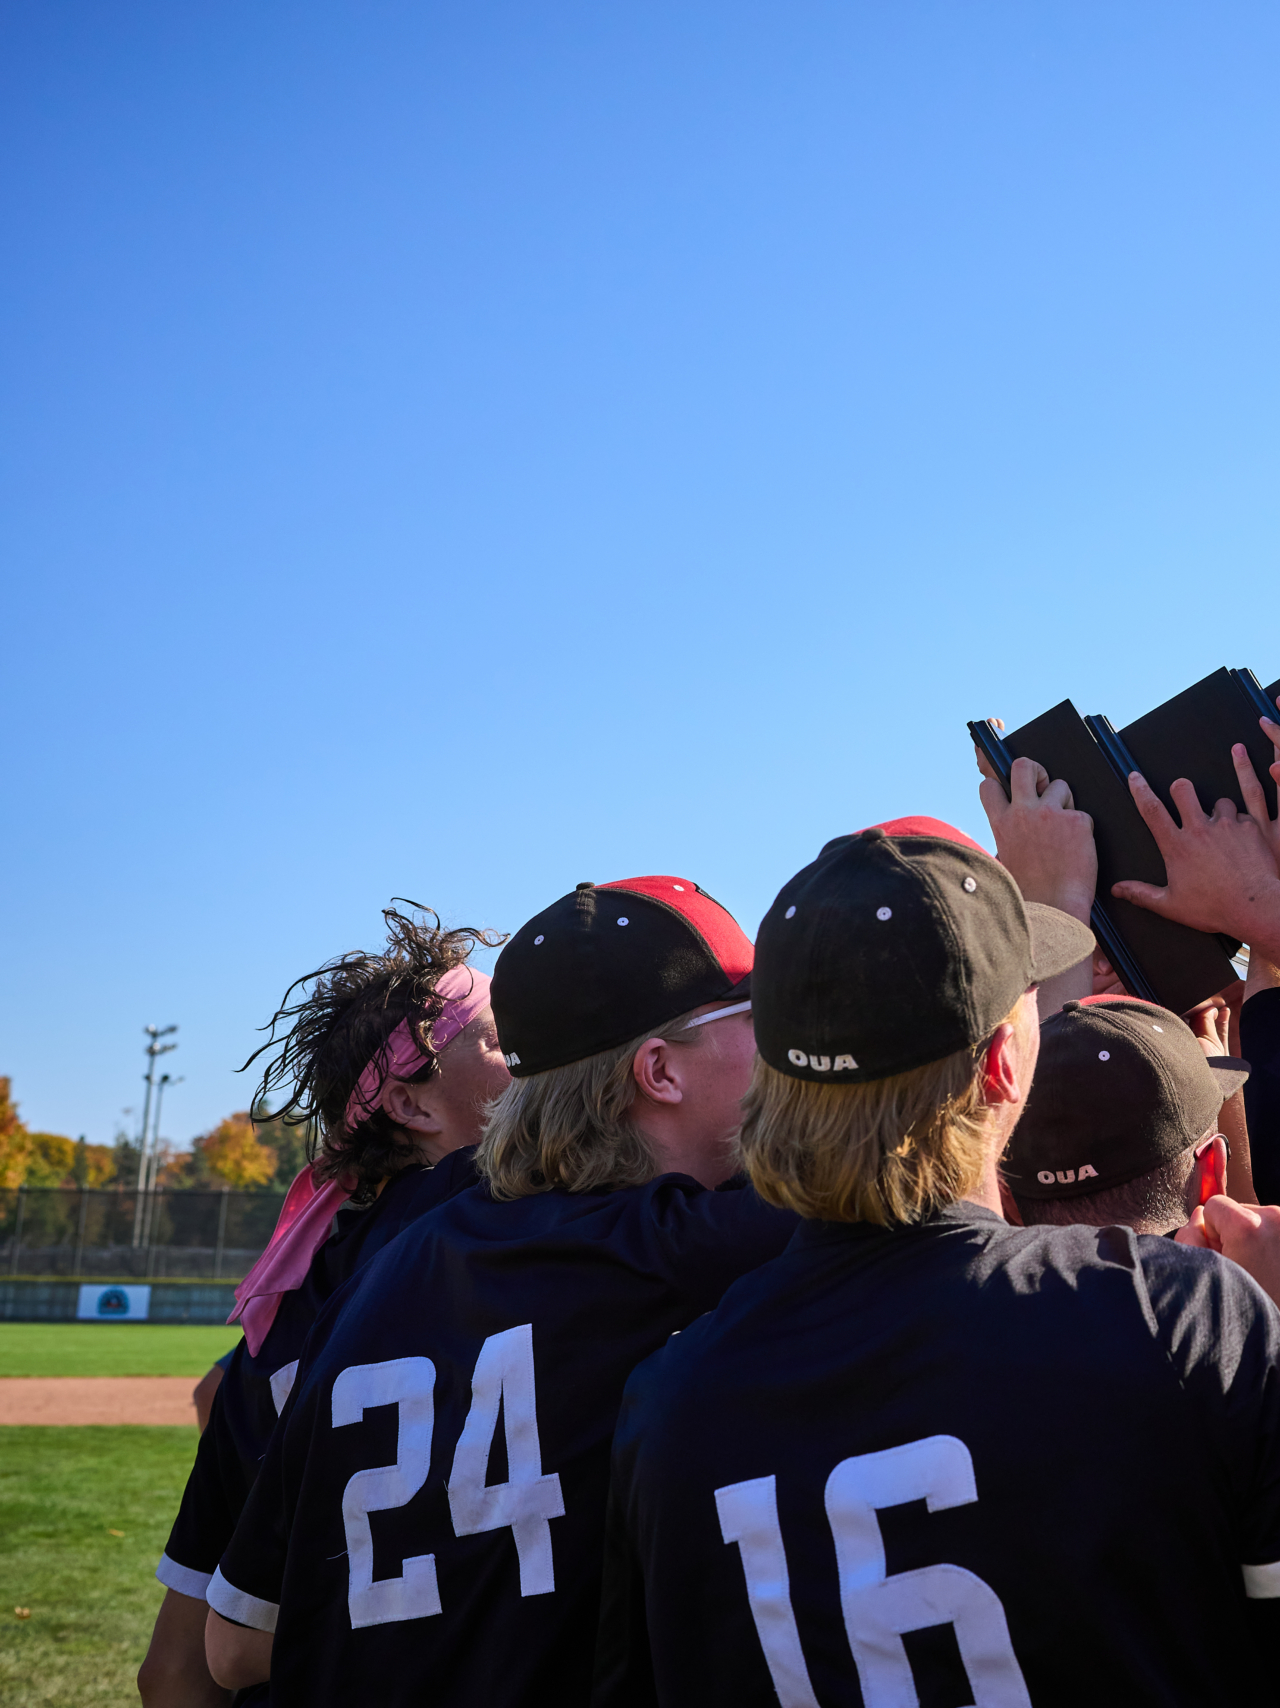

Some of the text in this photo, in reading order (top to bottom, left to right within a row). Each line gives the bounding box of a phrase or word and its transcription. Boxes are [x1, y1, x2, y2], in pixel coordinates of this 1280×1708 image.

[788, 1049, 859, 1072] OUA
[1037, 1164, 1099, 1185] OUA
[331, 1323, 565, 1629] 24
[714, 1434, 1032, 1708] 16
